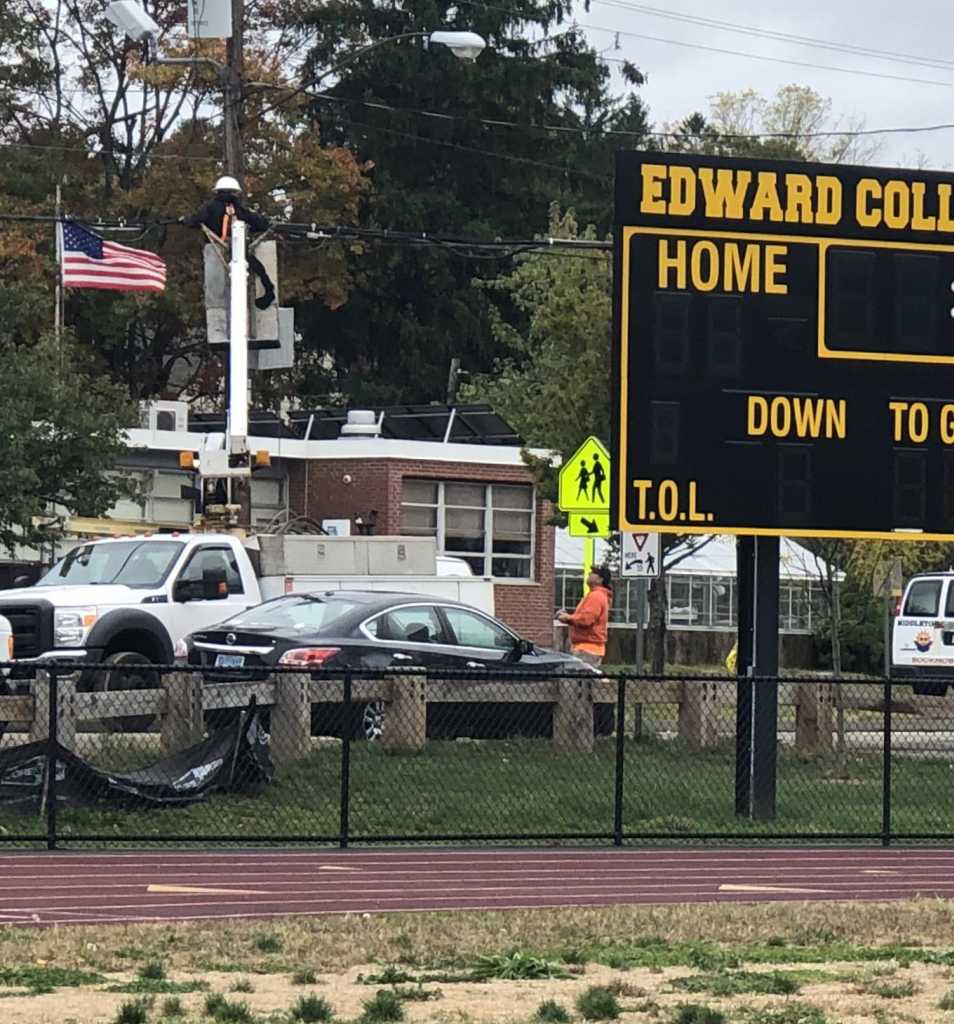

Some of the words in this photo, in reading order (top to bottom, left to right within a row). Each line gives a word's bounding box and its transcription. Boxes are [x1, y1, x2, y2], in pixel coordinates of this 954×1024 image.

[640, 163, 843, 226] EDWARD
[657, 239, 789, 295] HOME
[746, 395, 847, 439] DOWN
[889, 402, 928, 443] TO
[633, 479, 715, 522] T.O.L.
